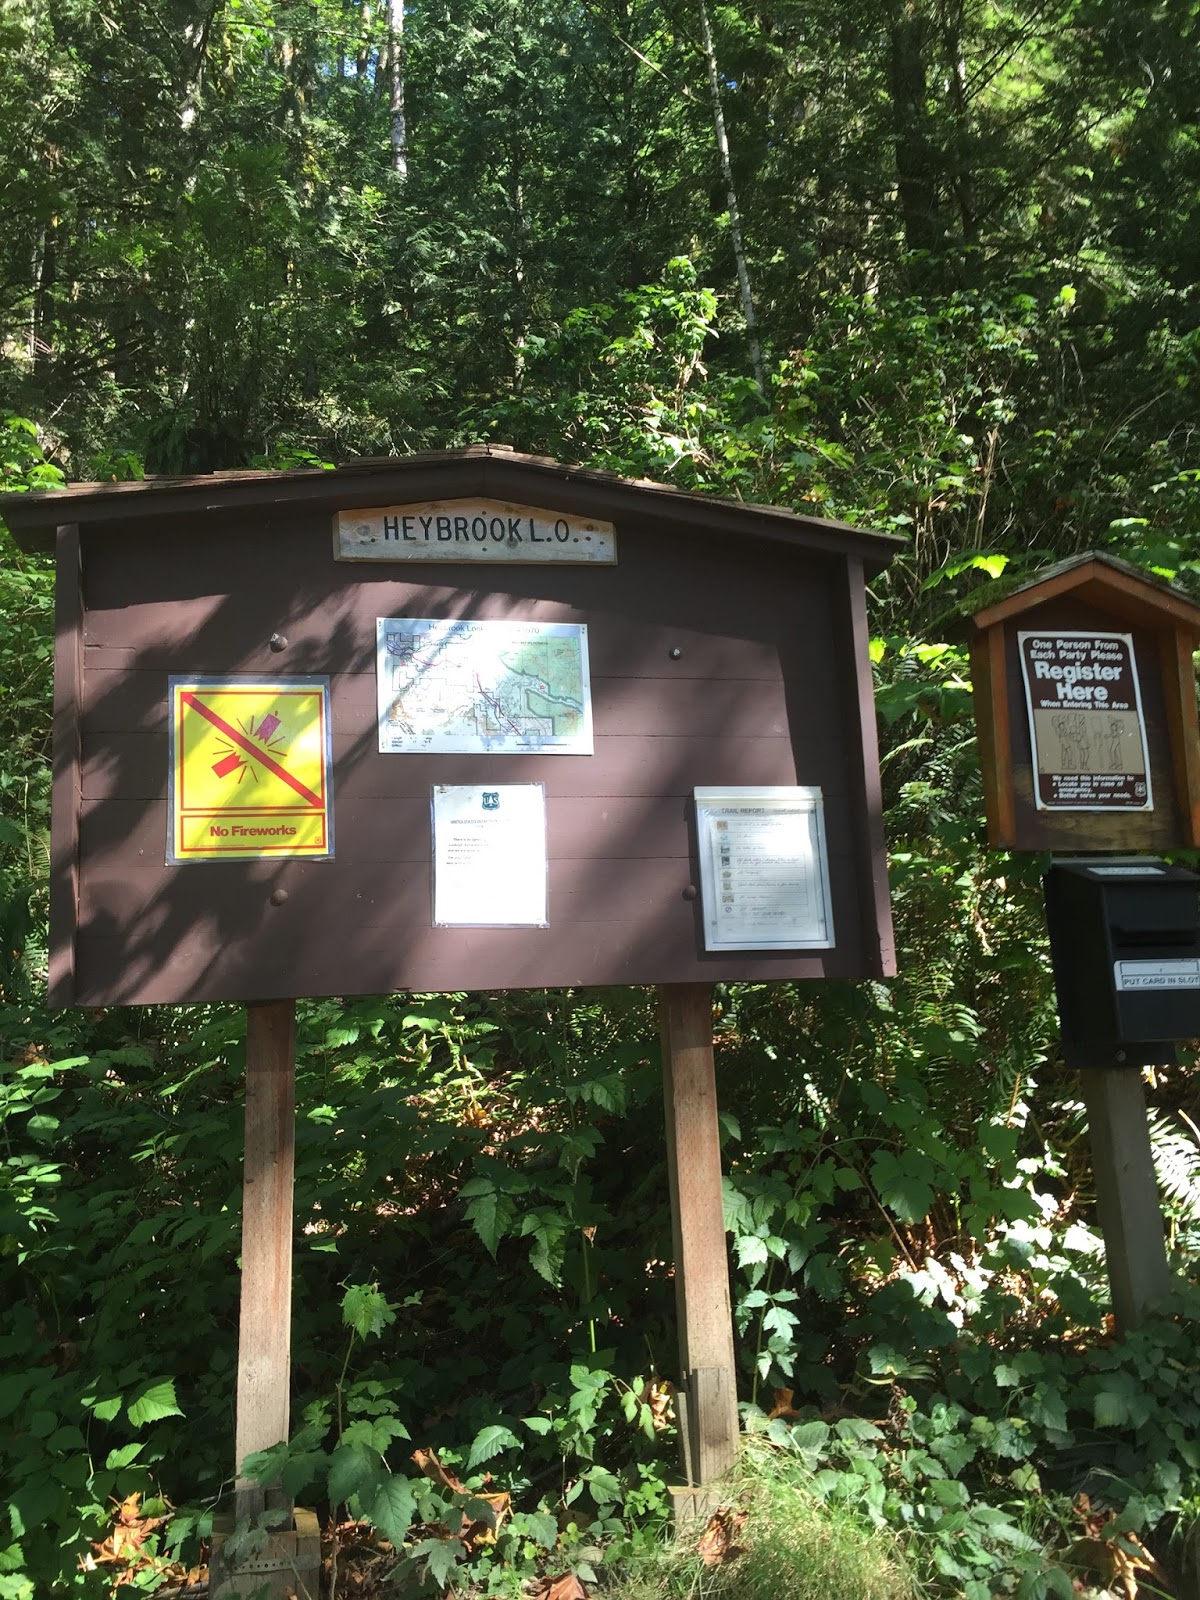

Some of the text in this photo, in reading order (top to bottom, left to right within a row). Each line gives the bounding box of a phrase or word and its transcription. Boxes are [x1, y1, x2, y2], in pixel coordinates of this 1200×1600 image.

[383, 515, 523, 542] HEYBROOK
[1032, 639, 1119, 650] One Person From
[1030, 649, 1123, 661] Each Party Please
[1034, 661, 1122, 684] Register
[1056, 682, 1108, 700] Here
[1040, 700, 1129, 709] When Entering This Area
[210, 825, 297, 837] No Fireworks
[1178, 976, 1199, 984] SLOT
